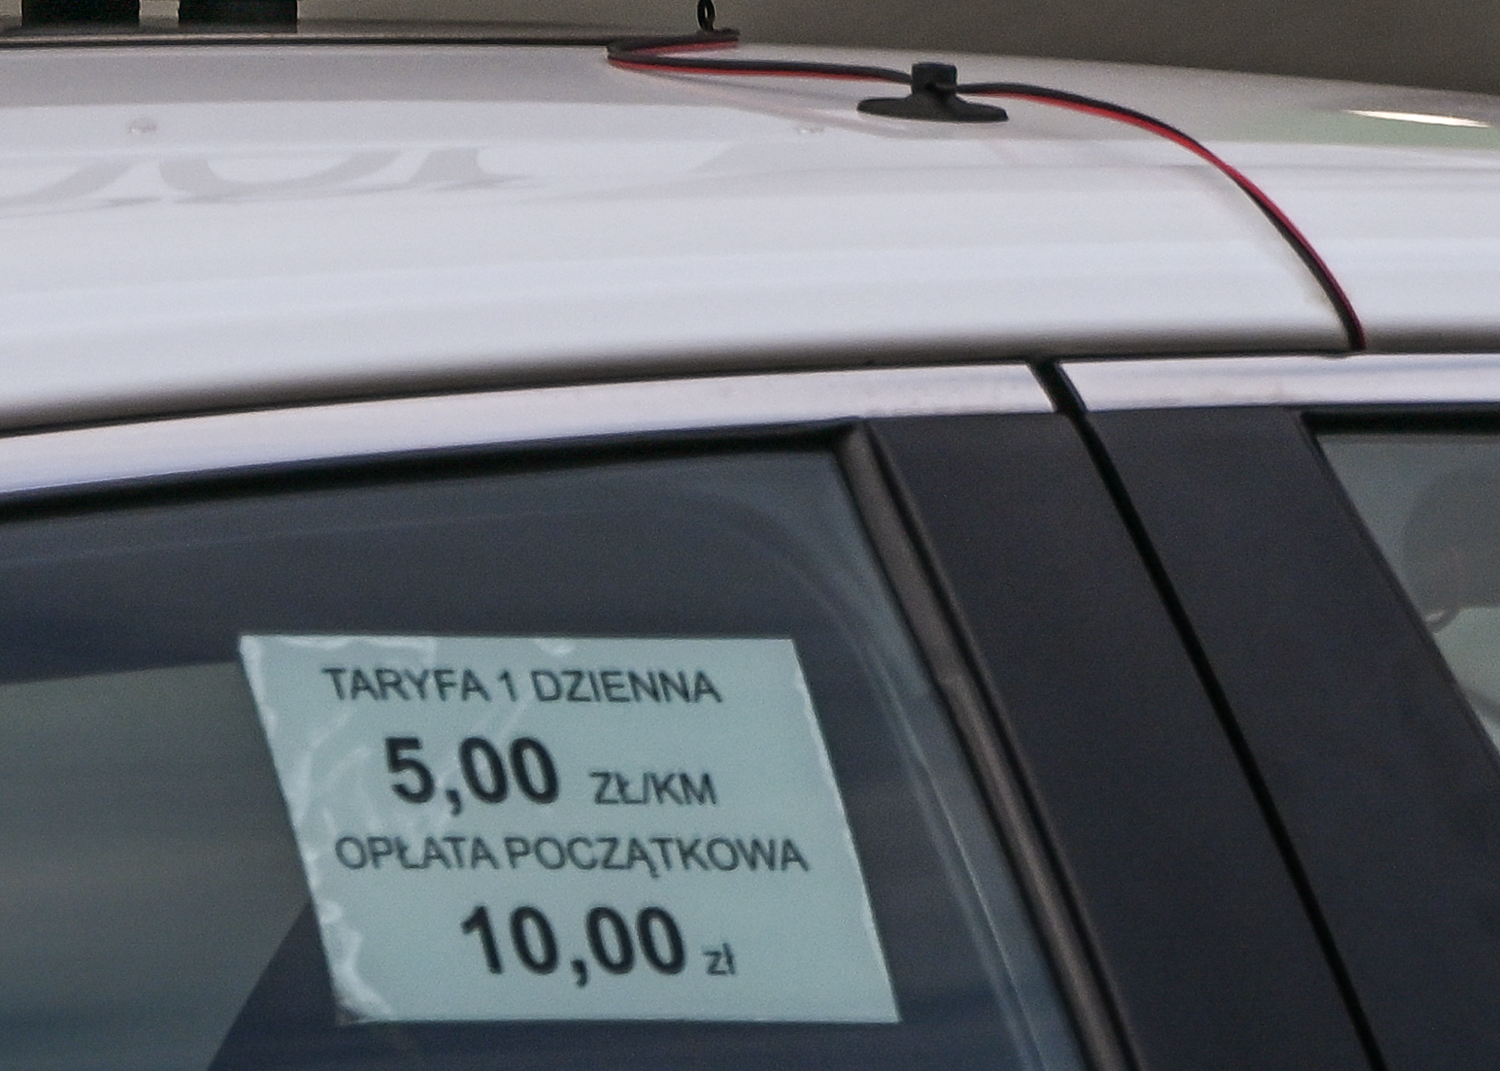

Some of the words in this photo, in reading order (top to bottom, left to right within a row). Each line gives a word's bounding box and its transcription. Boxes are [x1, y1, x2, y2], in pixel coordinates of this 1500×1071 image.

[322, 667, 489, 703] TARYFA
[499, 669, 518, 702] 1
[532, 669, 722, 704] DZIENNA
[383, 736, 559, 816] 5,00
[590, 771, 717, 805] ZŁ/KM
[335, 835, 498, 871] OPŁATA
[506, 836, 810, 878] POCZĄTKOWA
[461, 904, 686, 988] 10,00
[704, 943, 737, 977] zł
